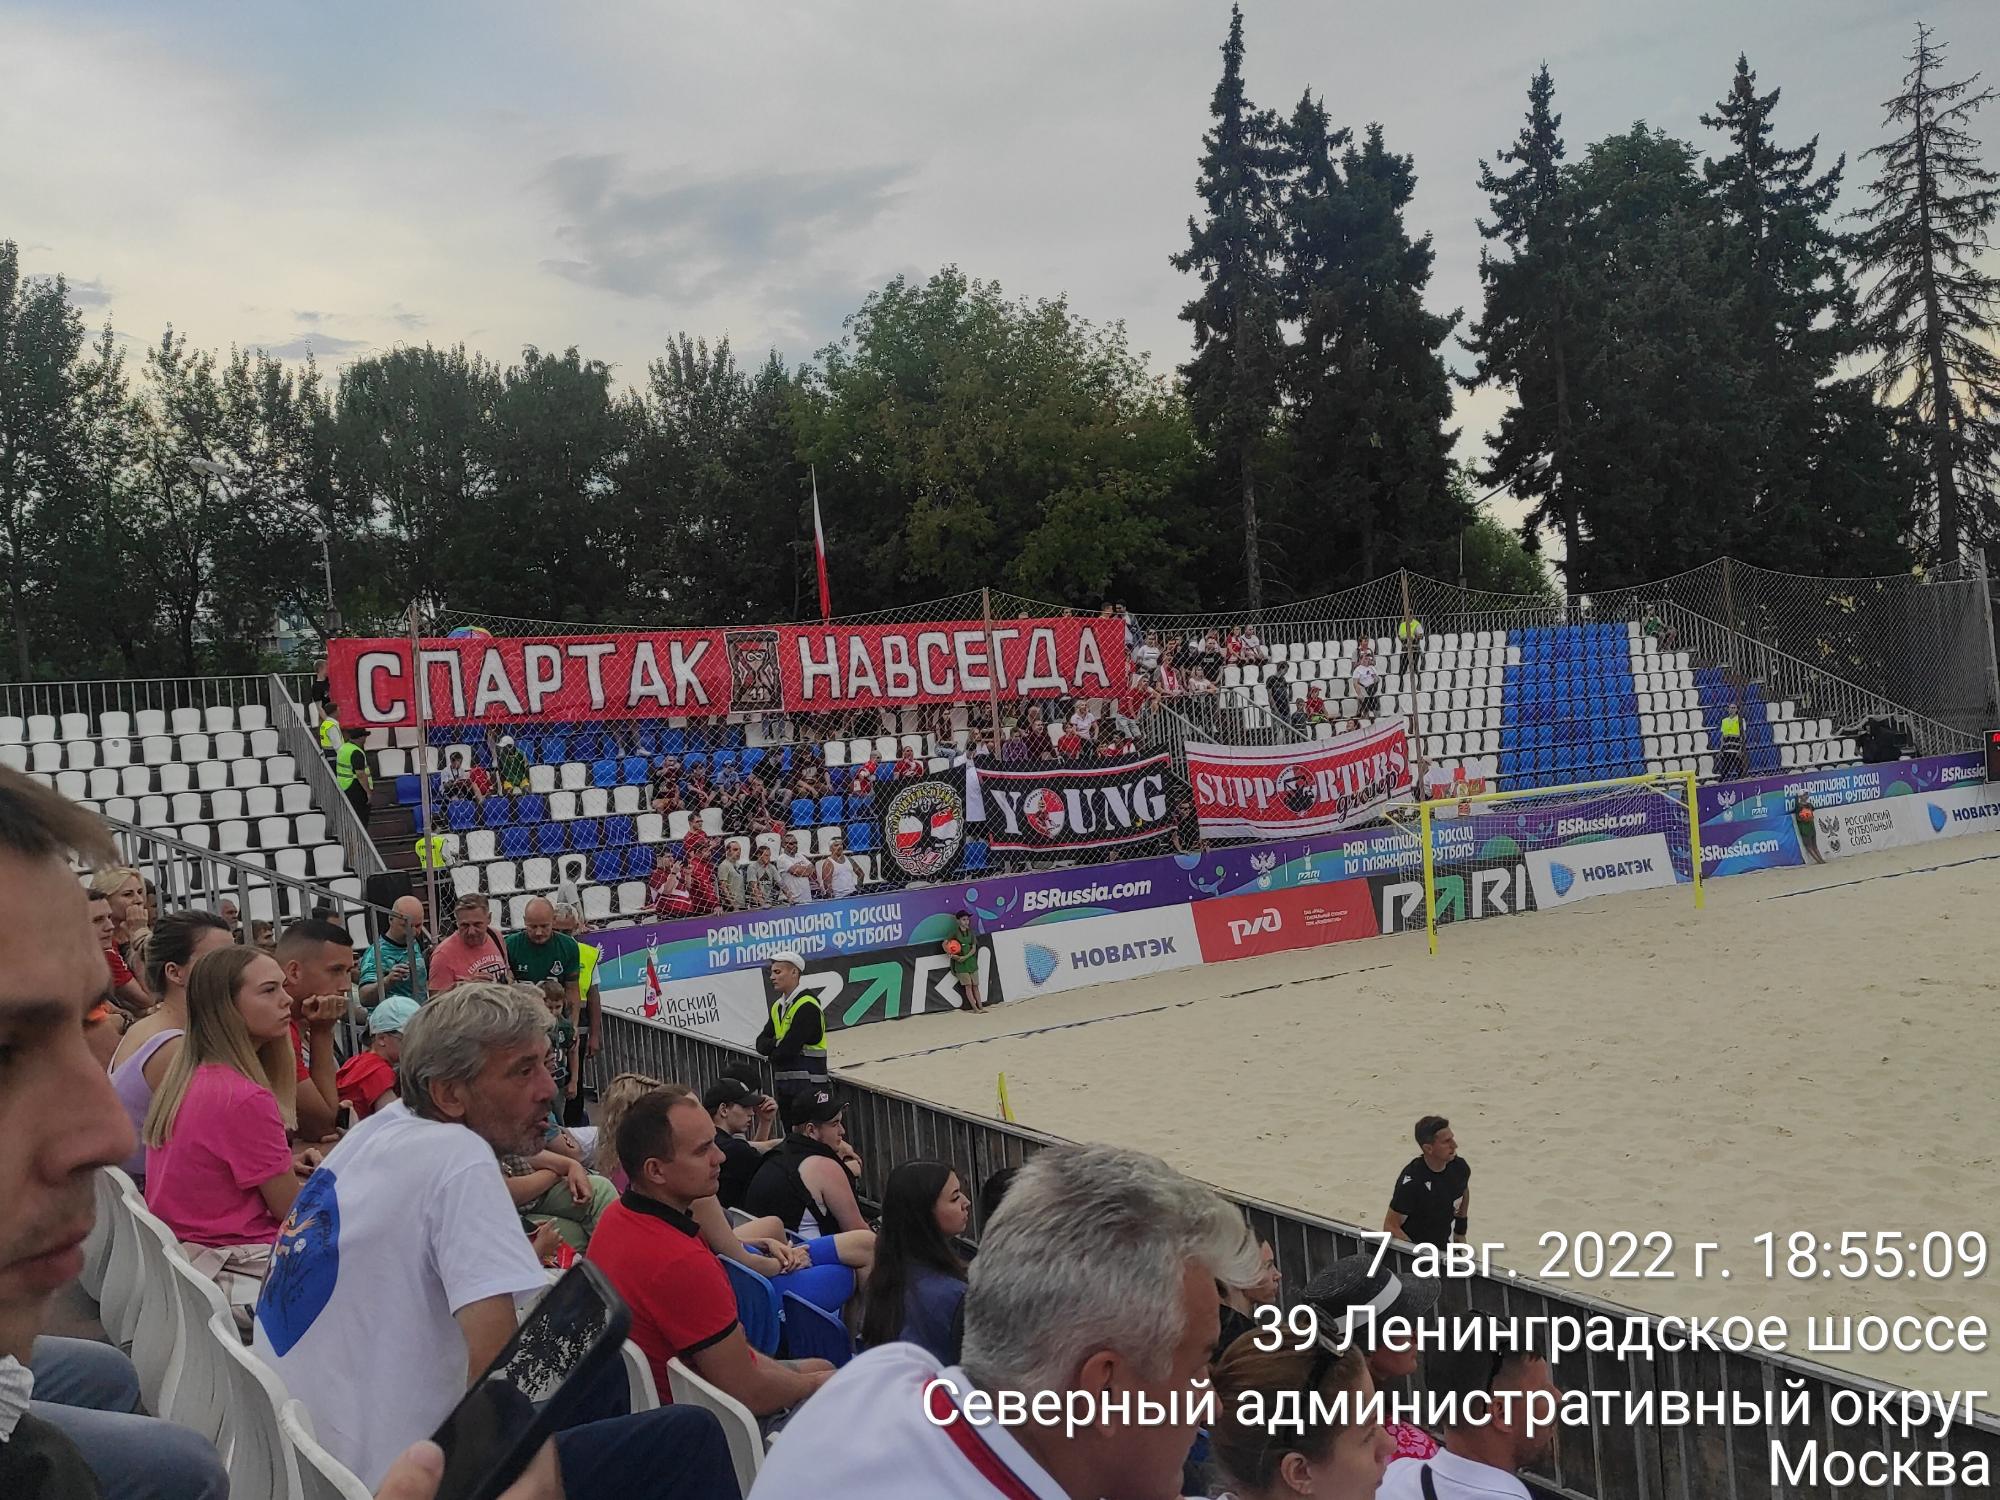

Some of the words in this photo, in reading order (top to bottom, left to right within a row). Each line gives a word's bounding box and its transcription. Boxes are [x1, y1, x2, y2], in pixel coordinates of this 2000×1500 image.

[798, 627, 1111, 700] НАВСЕГДА
[358, 640, 711, 723] СПАРТАК
[1196, 741, 1407, 810] SUPPORTERS
[1941, 763, 1986, 783] BSRussia
[990, 773, 1167, 840] YOUNG
[1844, 809, 1892, 827] РОССИЙСКИЙ
[1558, 811, 1647, 836] BSRussia.com
[1847, 820, 1894, 835] ФУТБОЛЬНЫЙ
[1343, 840, 1368, 857] PARI
[1699, 838, 1780, 862] BSRussia.com
[1850, 835, 1873, 847] СОЮЗ
[1345, 859, 1359, 875] ПО
[1582, 858, 1654, 882] НОВАТЭК
[1022, 880, 1152, 912] BSRussia.com
[707, 925, 743, 947] PARI
[709, 949, 730, 968] ПО
[832, 923, 903, 949] ФУТБОЛУ
[1071, 937, 1177, 970] НОВАТЭК
[638, 963, 672, 977] PRI
